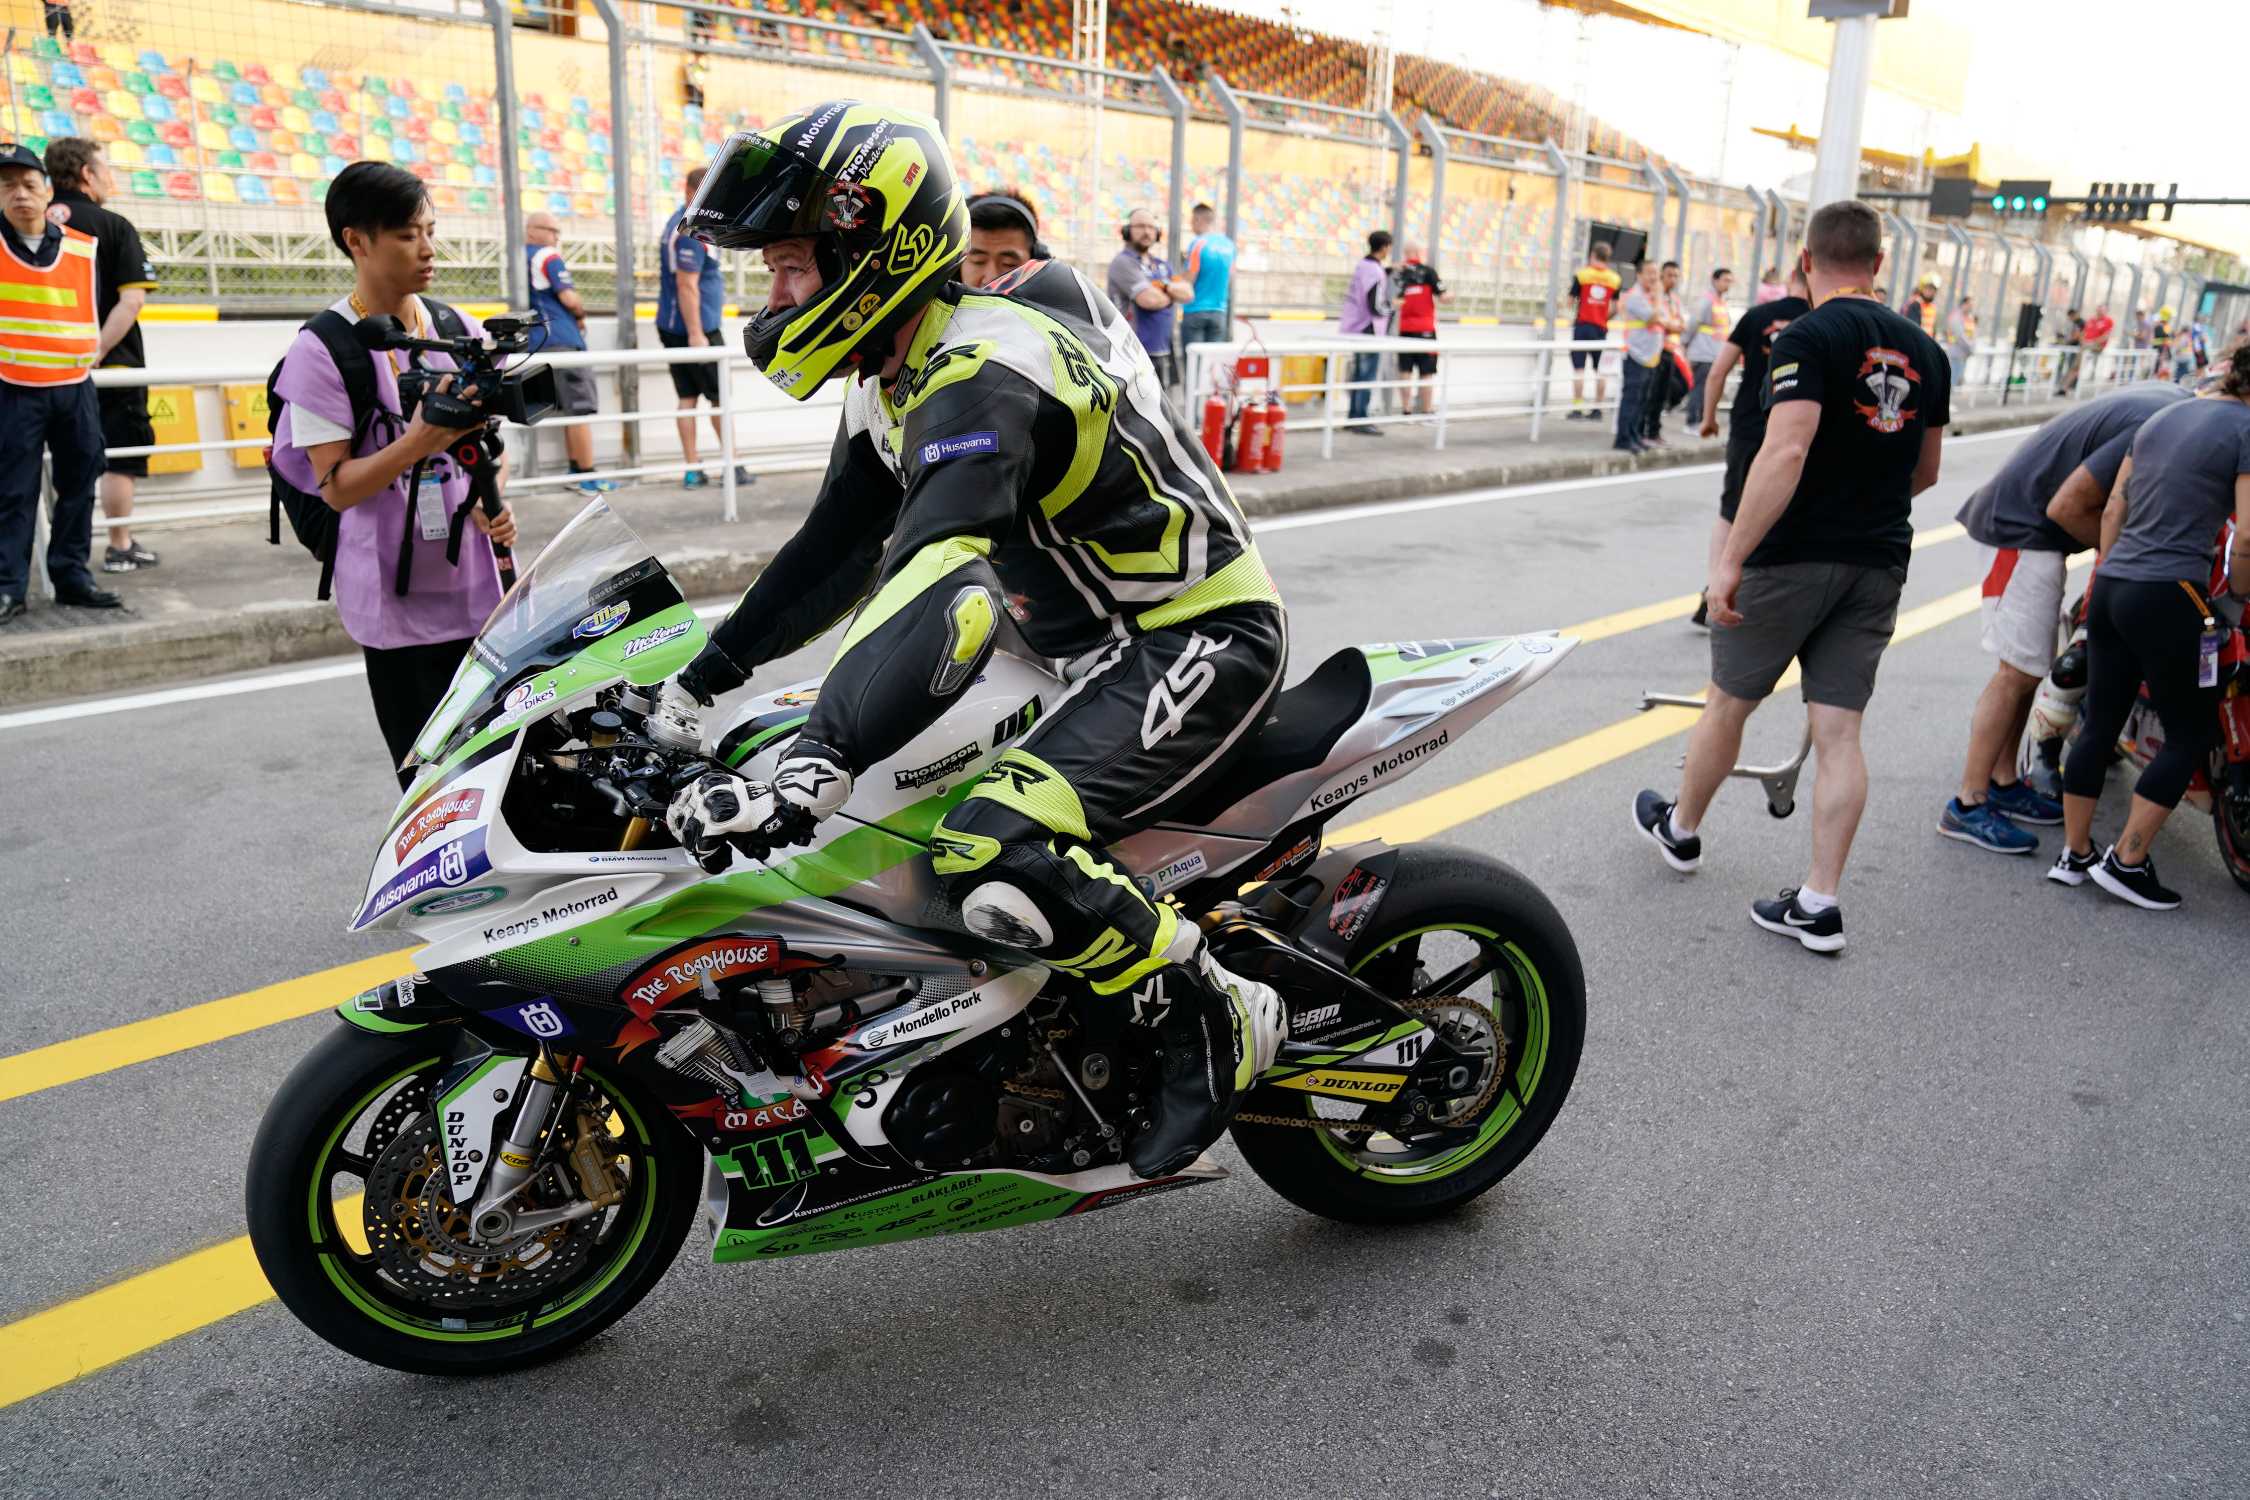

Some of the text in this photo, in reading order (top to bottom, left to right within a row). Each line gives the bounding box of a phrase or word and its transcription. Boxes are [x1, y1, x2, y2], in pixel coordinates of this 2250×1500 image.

[803, 102, 848, 148] Motorrad
[839, 119, 889, 182] THOMPSON
[941, 437, 991, 453] Husqvarna
[1140, 630, 1233, 750] 45R
[896, 743, 977, 782] THOMPSON
[1309, 729, 1449, 812] Kearys Motorrad
[600, 854, 669, 863] BMW Motorrad
[1158, 855, 1202, 882] PTAqua
[374, 865, 438, 917] Husqvarna
[483, 915, 540, 945] Kearys
[542, 886, 619, 927] Motorrad
[1344, 912, 1365, 941] Crash
[632, 944, 769, 1006] THE ROADHOUSE
[893, 990, 982, 1038] Mondello Park
[1292, 1003, 1341, 1029] SBM
[1396, 1034, 1423, 1065] 111
[1320, 1078, 1401, 1093] DUNLOP
[446, 1111, 472, 1186] DUNLOP
[728, 1129, 821, 1190] 111
